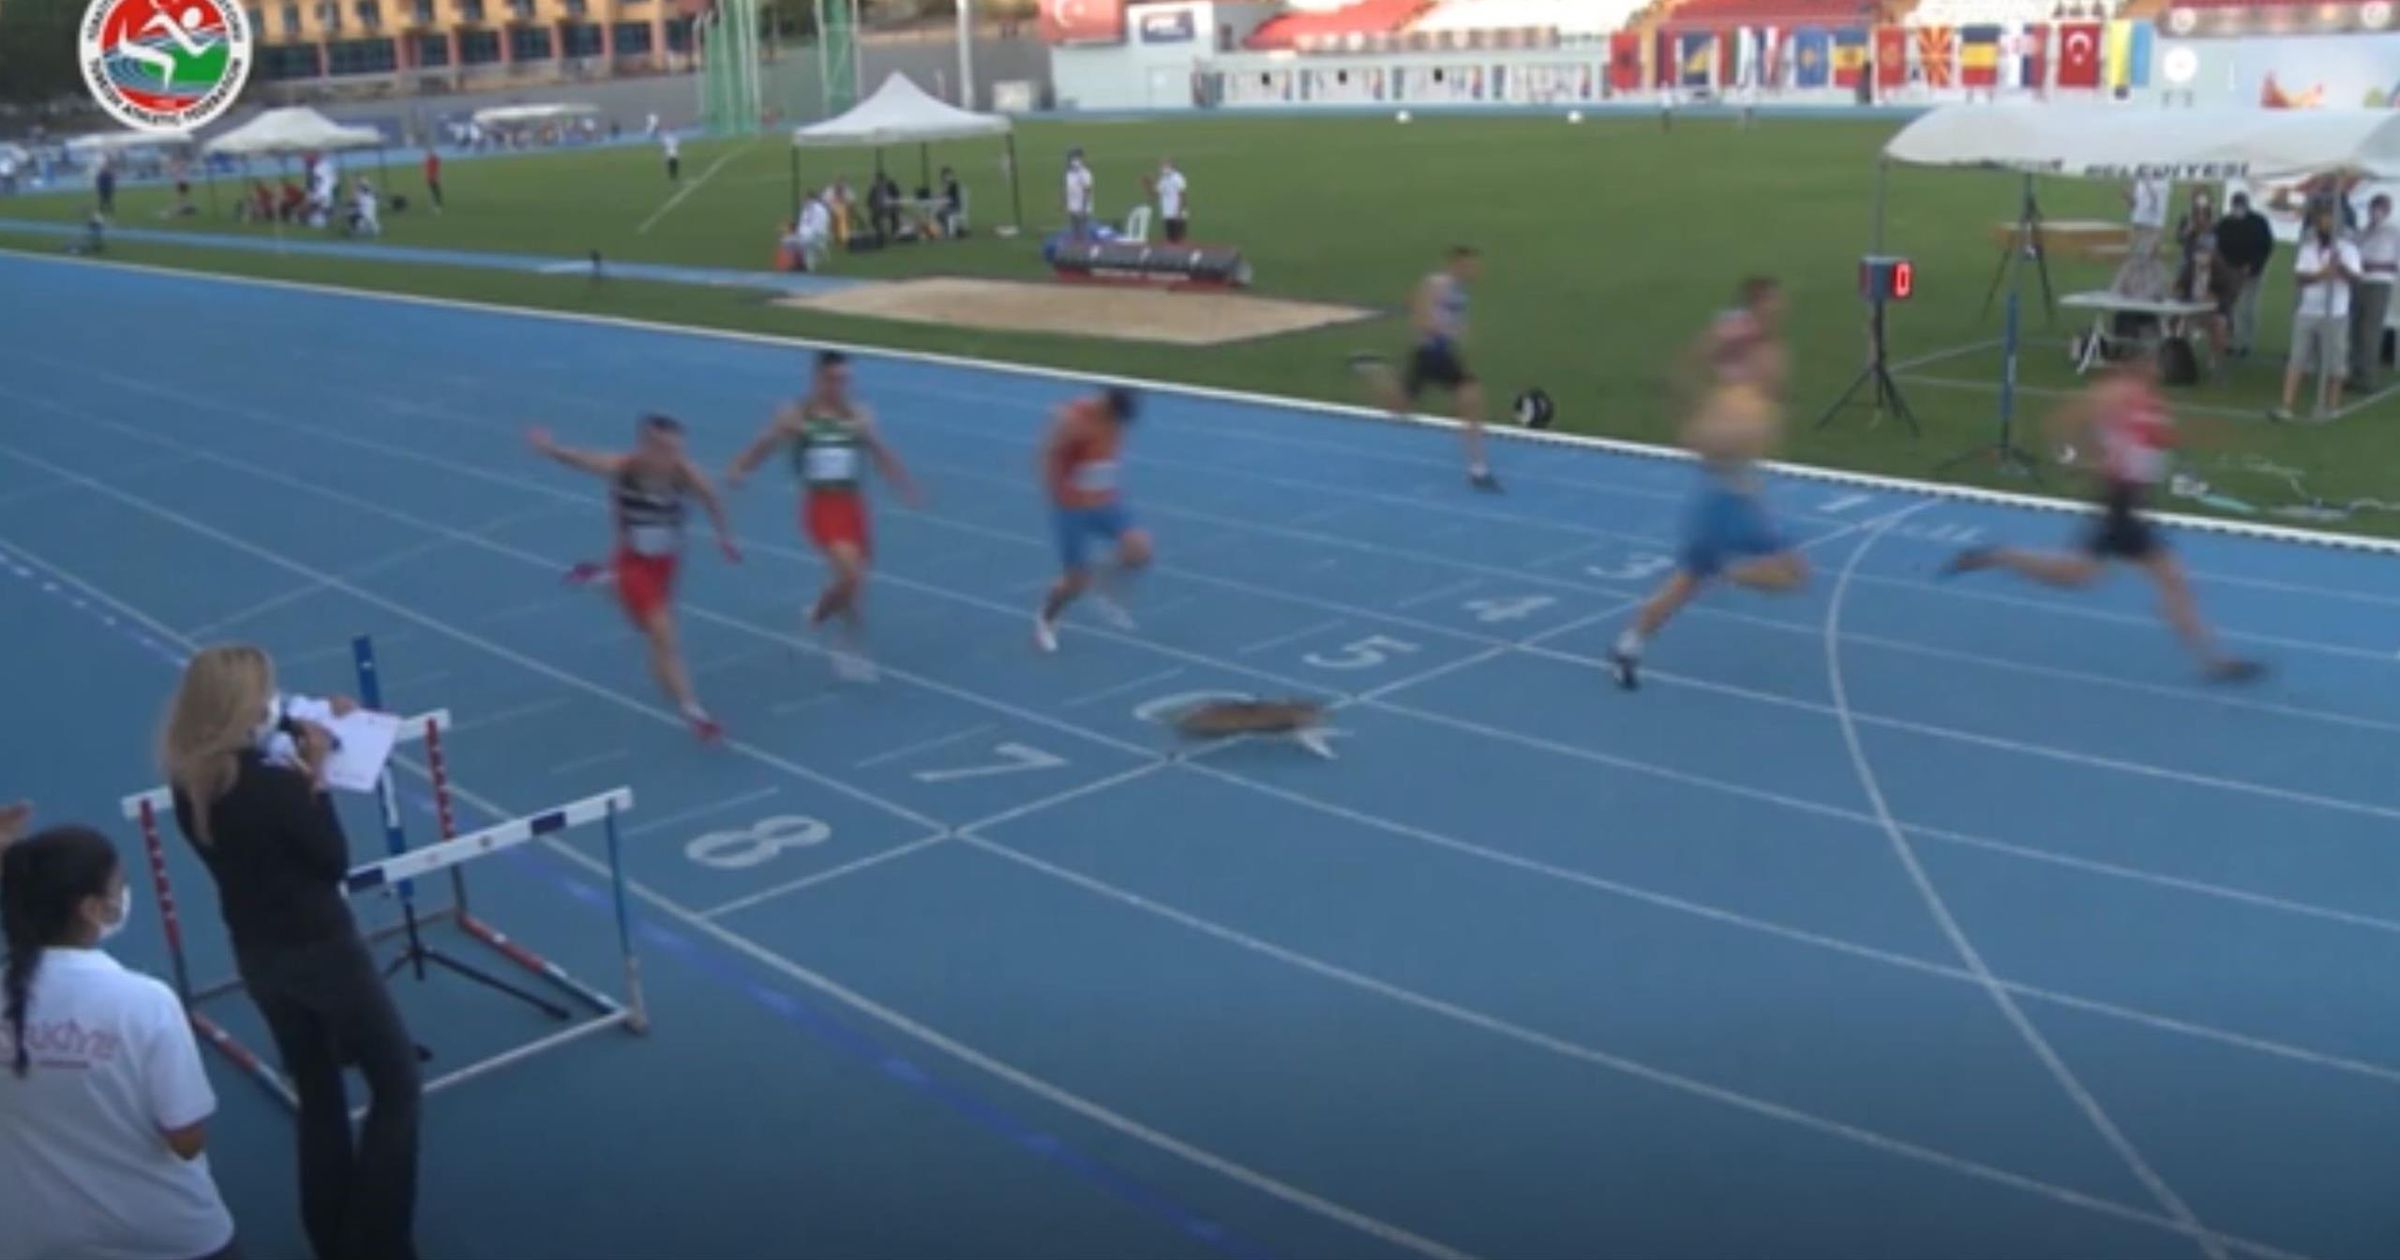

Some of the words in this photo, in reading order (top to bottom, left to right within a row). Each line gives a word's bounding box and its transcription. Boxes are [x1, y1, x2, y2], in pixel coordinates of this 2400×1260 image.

[1895, 261, 1911, 298] 0
[1583, 551, 1676, 579] 3
[1460, 596, 1557, 622] 4
[1302, 634, 1421, 670] 5
[911, 741, 1071, 783] 7
[684, 813, 833, 870] 8
